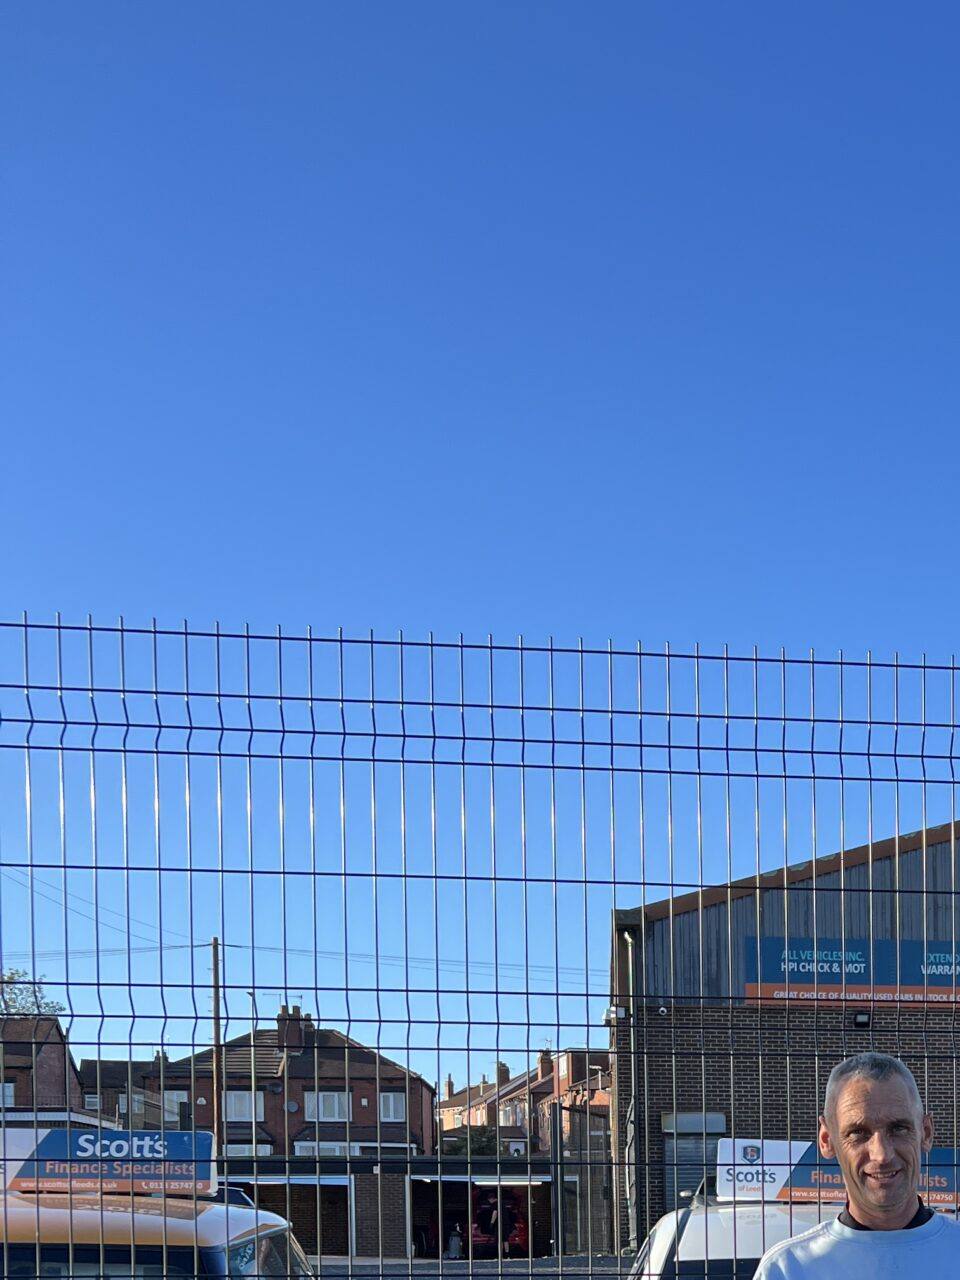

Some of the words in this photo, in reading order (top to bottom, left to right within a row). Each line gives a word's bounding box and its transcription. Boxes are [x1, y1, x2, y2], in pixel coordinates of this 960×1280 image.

[781, 963, 797, 972] HPI
[800, 991, 827, 1000] CHOCE
[76, 1134, 168, 1158] Scott's
[45, 1162, 109, 1174] Finance
[113, 1161, 196, 1177] Specialists
[726, 1167, 776, 1184] Scott's
[169, 1182, 204, 1190] 257470
[923, 1192, 953, 1201] 274750
